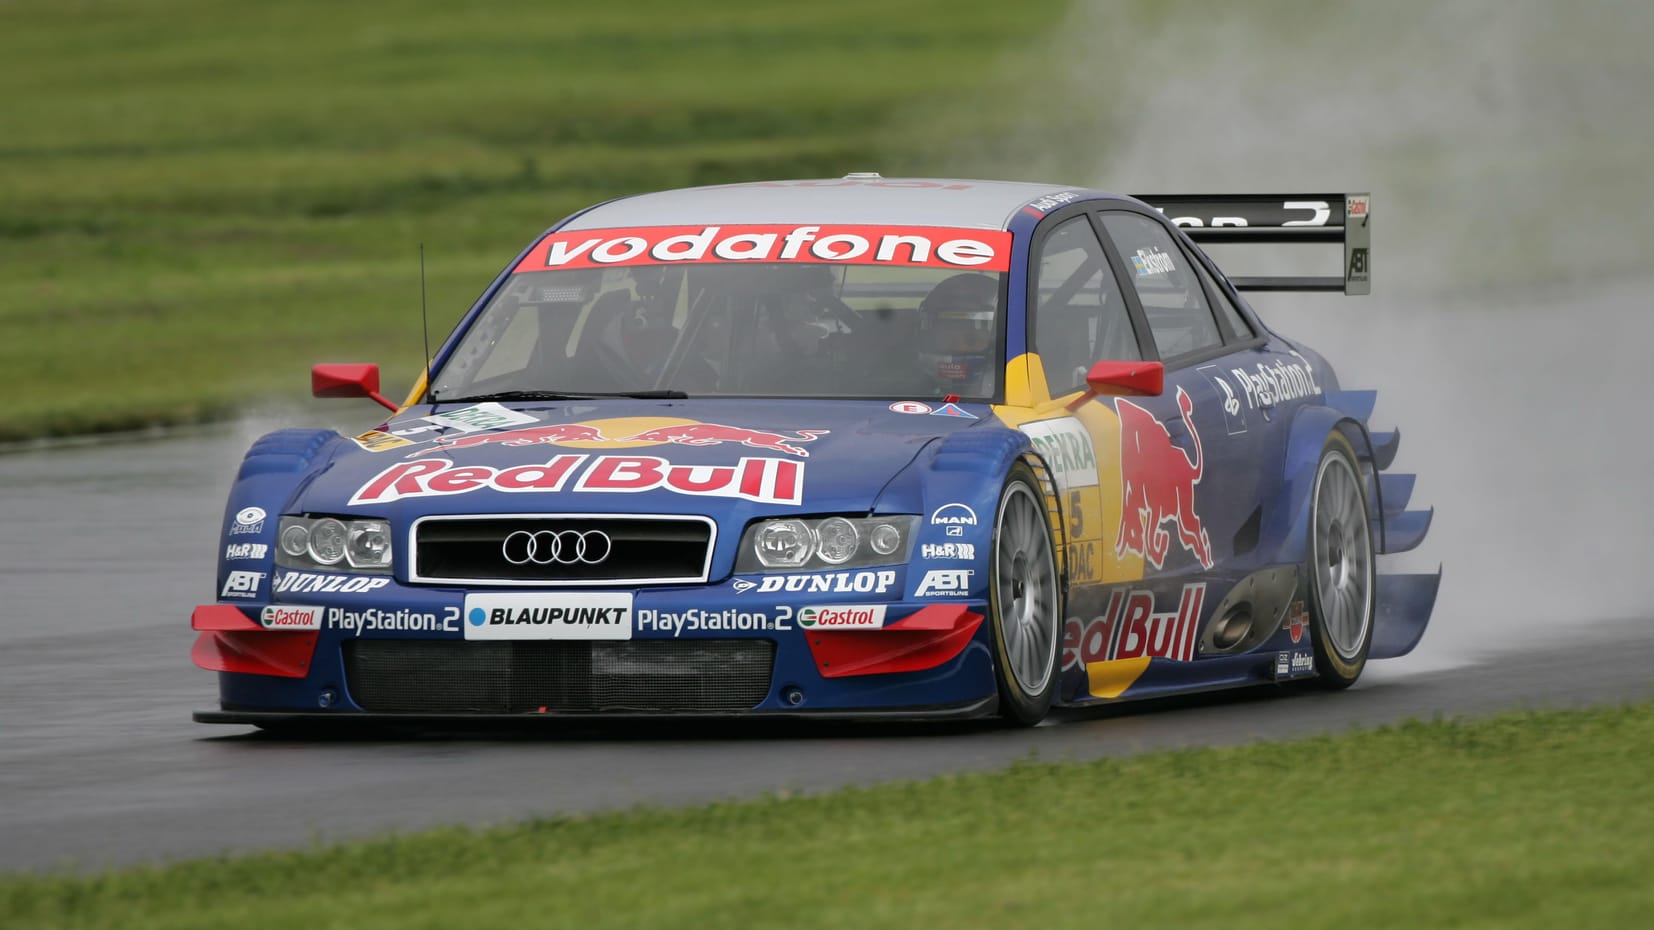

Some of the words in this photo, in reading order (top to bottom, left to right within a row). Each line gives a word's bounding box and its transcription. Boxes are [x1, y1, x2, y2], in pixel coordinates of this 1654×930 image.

[546, 226, 995, 266] vodafone
[350, 456, 587, 504] Red
[575, 455, 804, 505] Bull
[1070, 490, 1084, 538] 5
[922, 543, 956, 558] H&R
[221, 571, 262, 597] ABT
[277, 571, 390, 593] DUNLOP
[756, 571, 895, 593] DUNLOP
[914, 570, 969, 597] ABT
[275, 609, 315, 625] Castrol
[490, 608, 627, 625] BLAUPUNKT
[818, 608, 875, 626] Castrol
[1113, 583, 1207, 662] Bull
